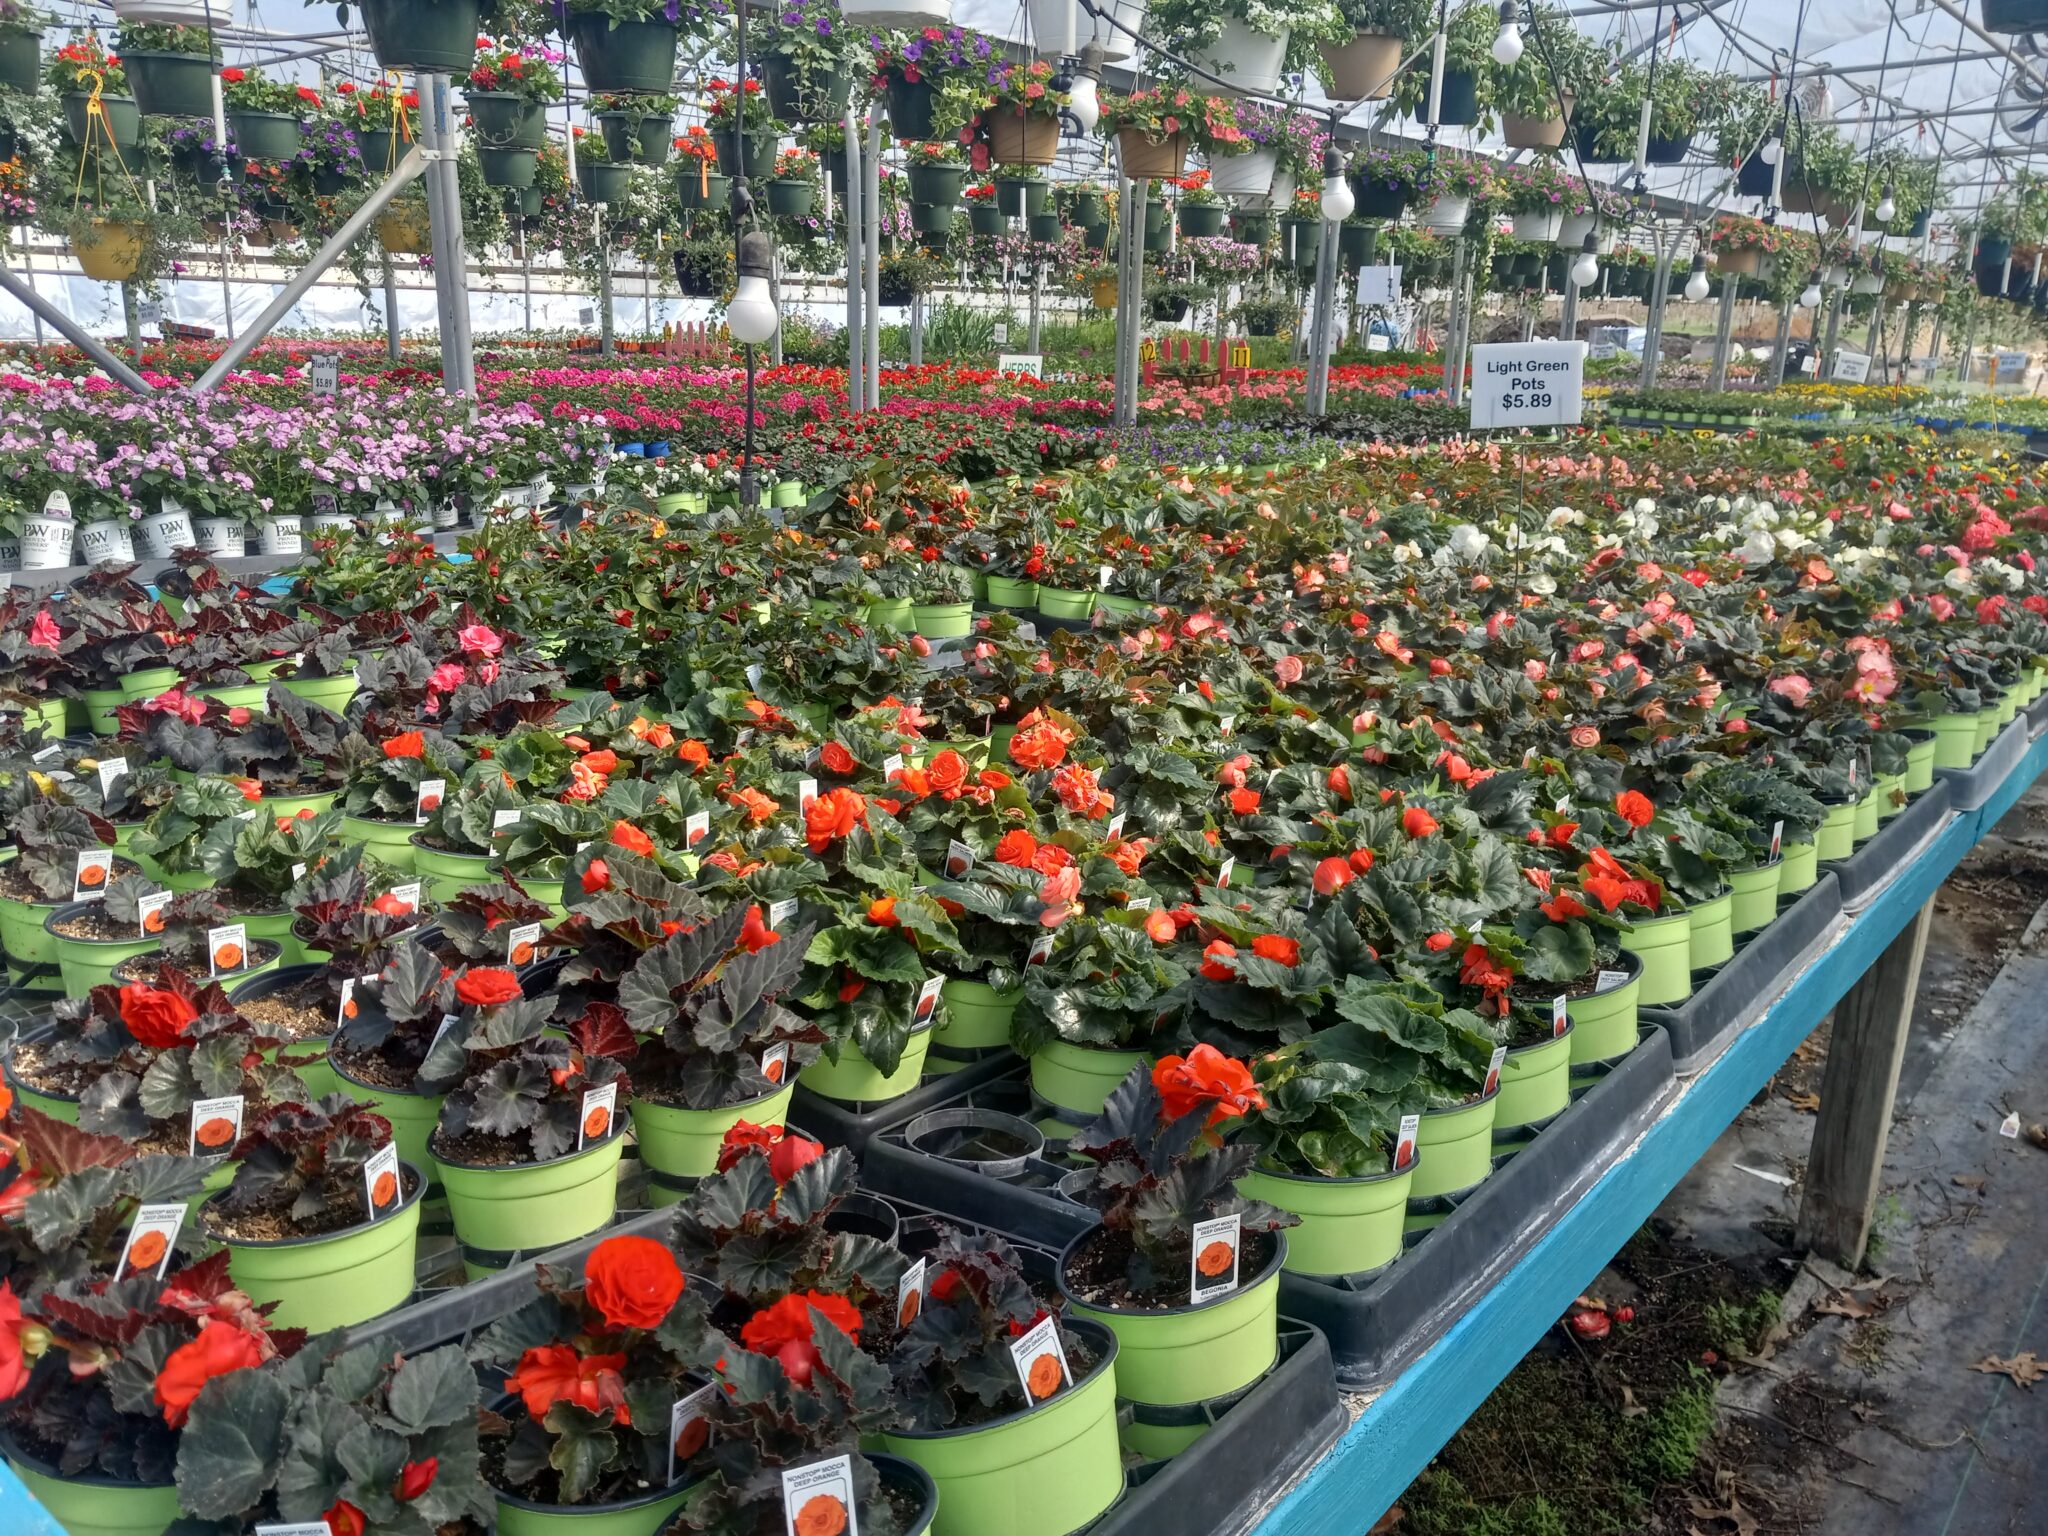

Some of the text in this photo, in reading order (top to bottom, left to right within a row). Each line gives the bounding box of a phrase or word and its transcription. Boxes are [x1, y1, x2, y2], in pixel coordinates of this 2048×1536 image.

[1140, 343, 1155, 362] 12
[1234, 349, 1247, 367] 11
[312, 358, 338, 368] Blue Pots
[1488, 360, 1569, 375] Light Green
[316, 378, 332, 388] $5.89
[1512, 378, 1546, 390] Pots
[1502, 392, 1552, 412] $5.89
[24, 524, 50, 537] PW
[158, 520, 184, 535] PW
[82, 530, 108, 546] PW
[1201, 1285, 1228, 1296] BEGONIA
[822, 1462, 846, 1473] MOCCA
[794, 1470, 840, 1487] DEEP ORANGE
